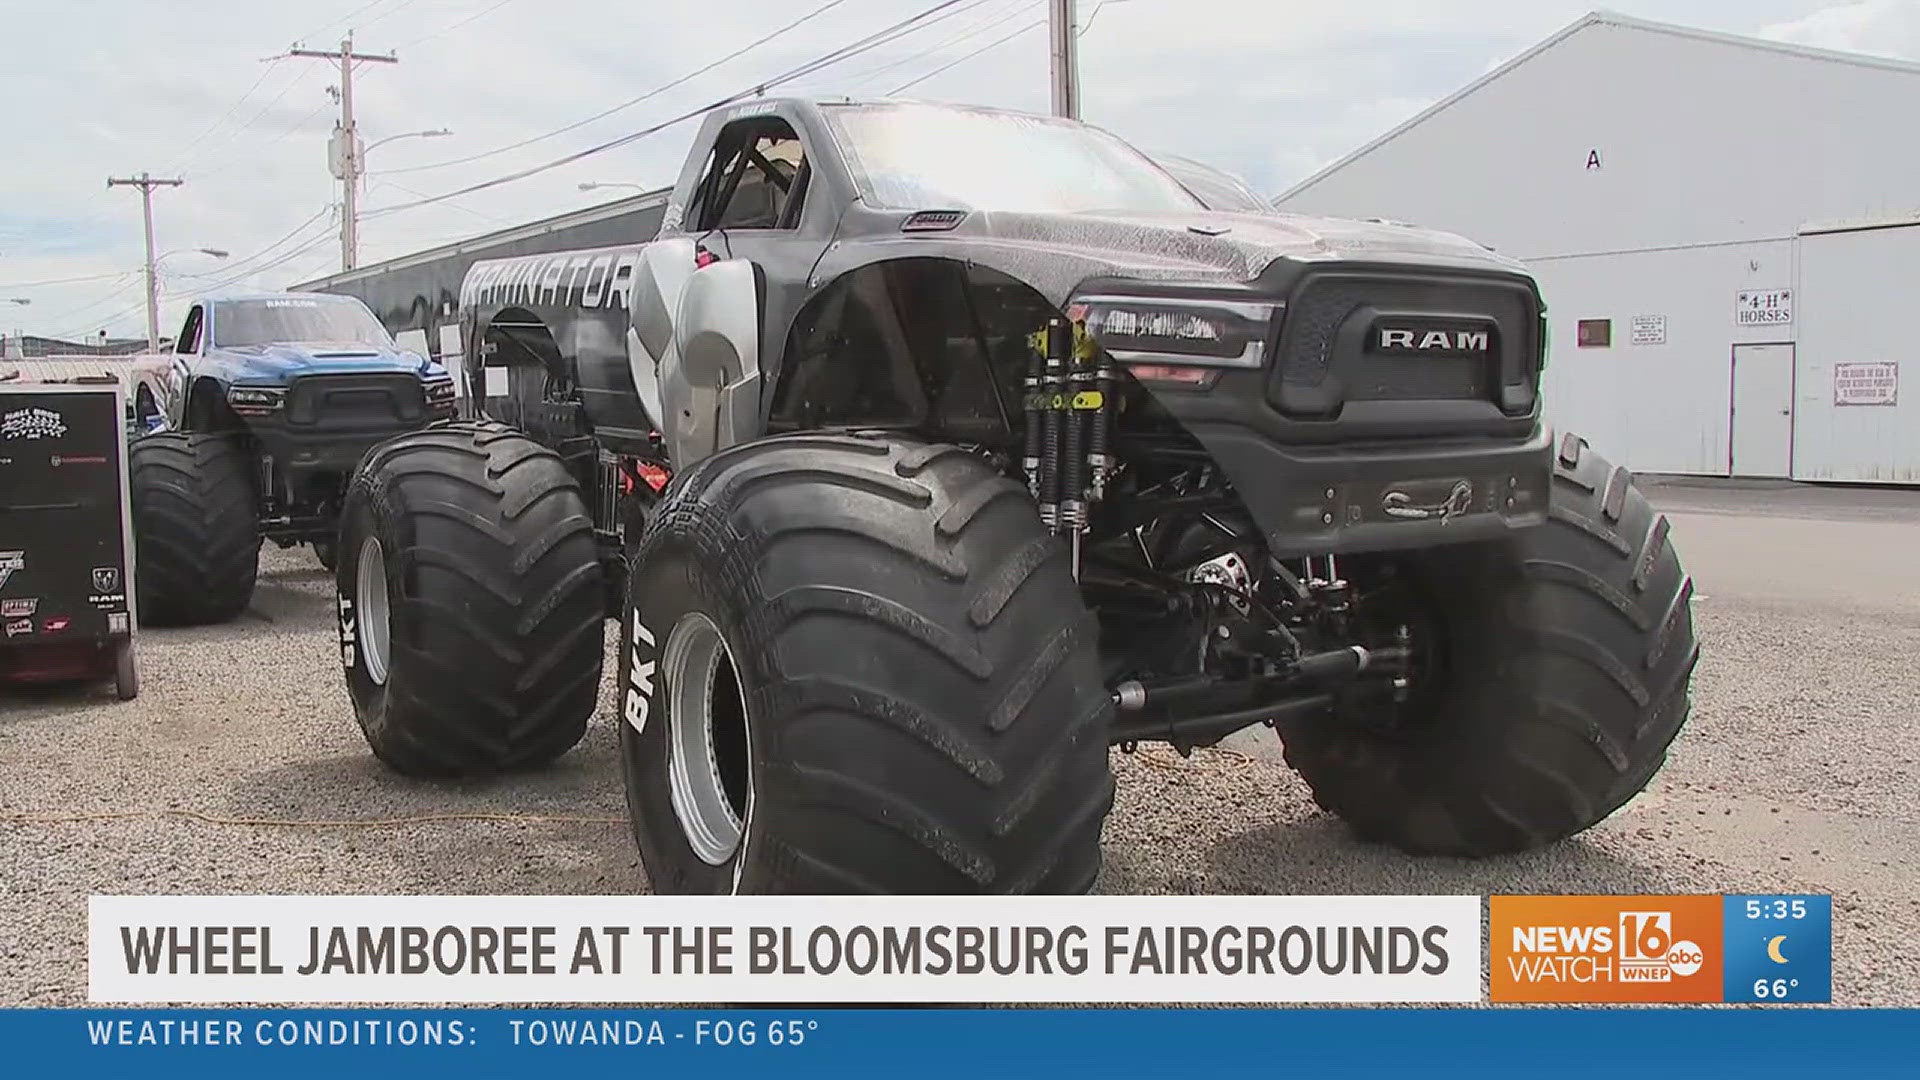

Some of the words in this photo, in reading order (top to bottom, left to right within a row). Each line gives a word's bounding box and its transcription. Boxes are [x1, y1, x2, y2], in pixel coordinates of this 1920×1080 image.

[1586, 149, 1600, 170] A
[464, 251, 632, 309] RAMINATOR
[1749, 294, 1778, 309] 4-H
[1740, 309, 1790, 323] HORSES
[1381, 330, 1488, 350] RAM
[89, 594, 124, 603] RAM
[338, 592, 356, 668] BKT
[624, 606, 656, 735] BKT
